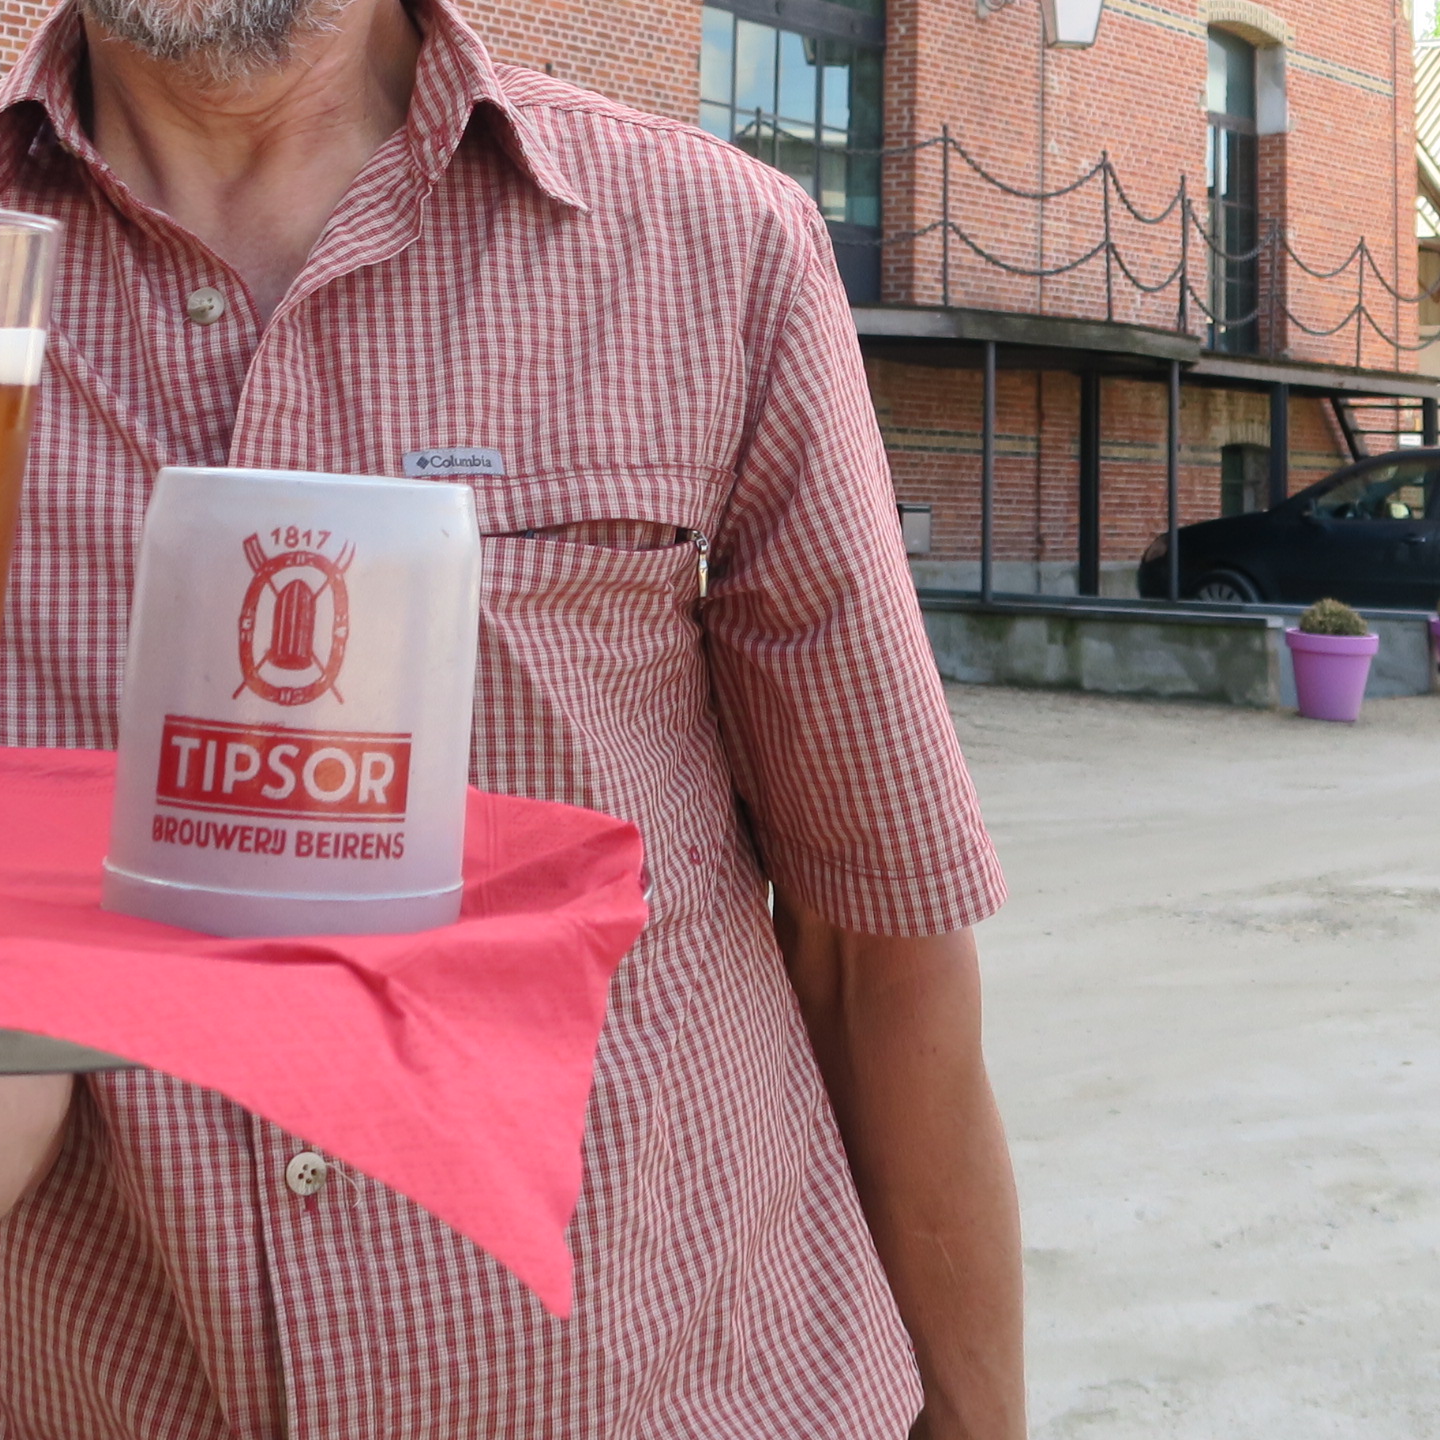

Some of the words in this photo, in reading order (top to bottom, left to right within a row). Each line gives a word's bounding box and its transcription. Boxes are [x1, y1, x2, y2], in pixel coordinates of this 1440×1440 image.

[430, 455, 492, 468] Columbia
[271, 525, 331, 549] 1817
[170, 735, 396, 805] TIPSOR
[152, 814, 286, 855] BROUWERIJ
[295, 831, 404, 860] BEIRENS
